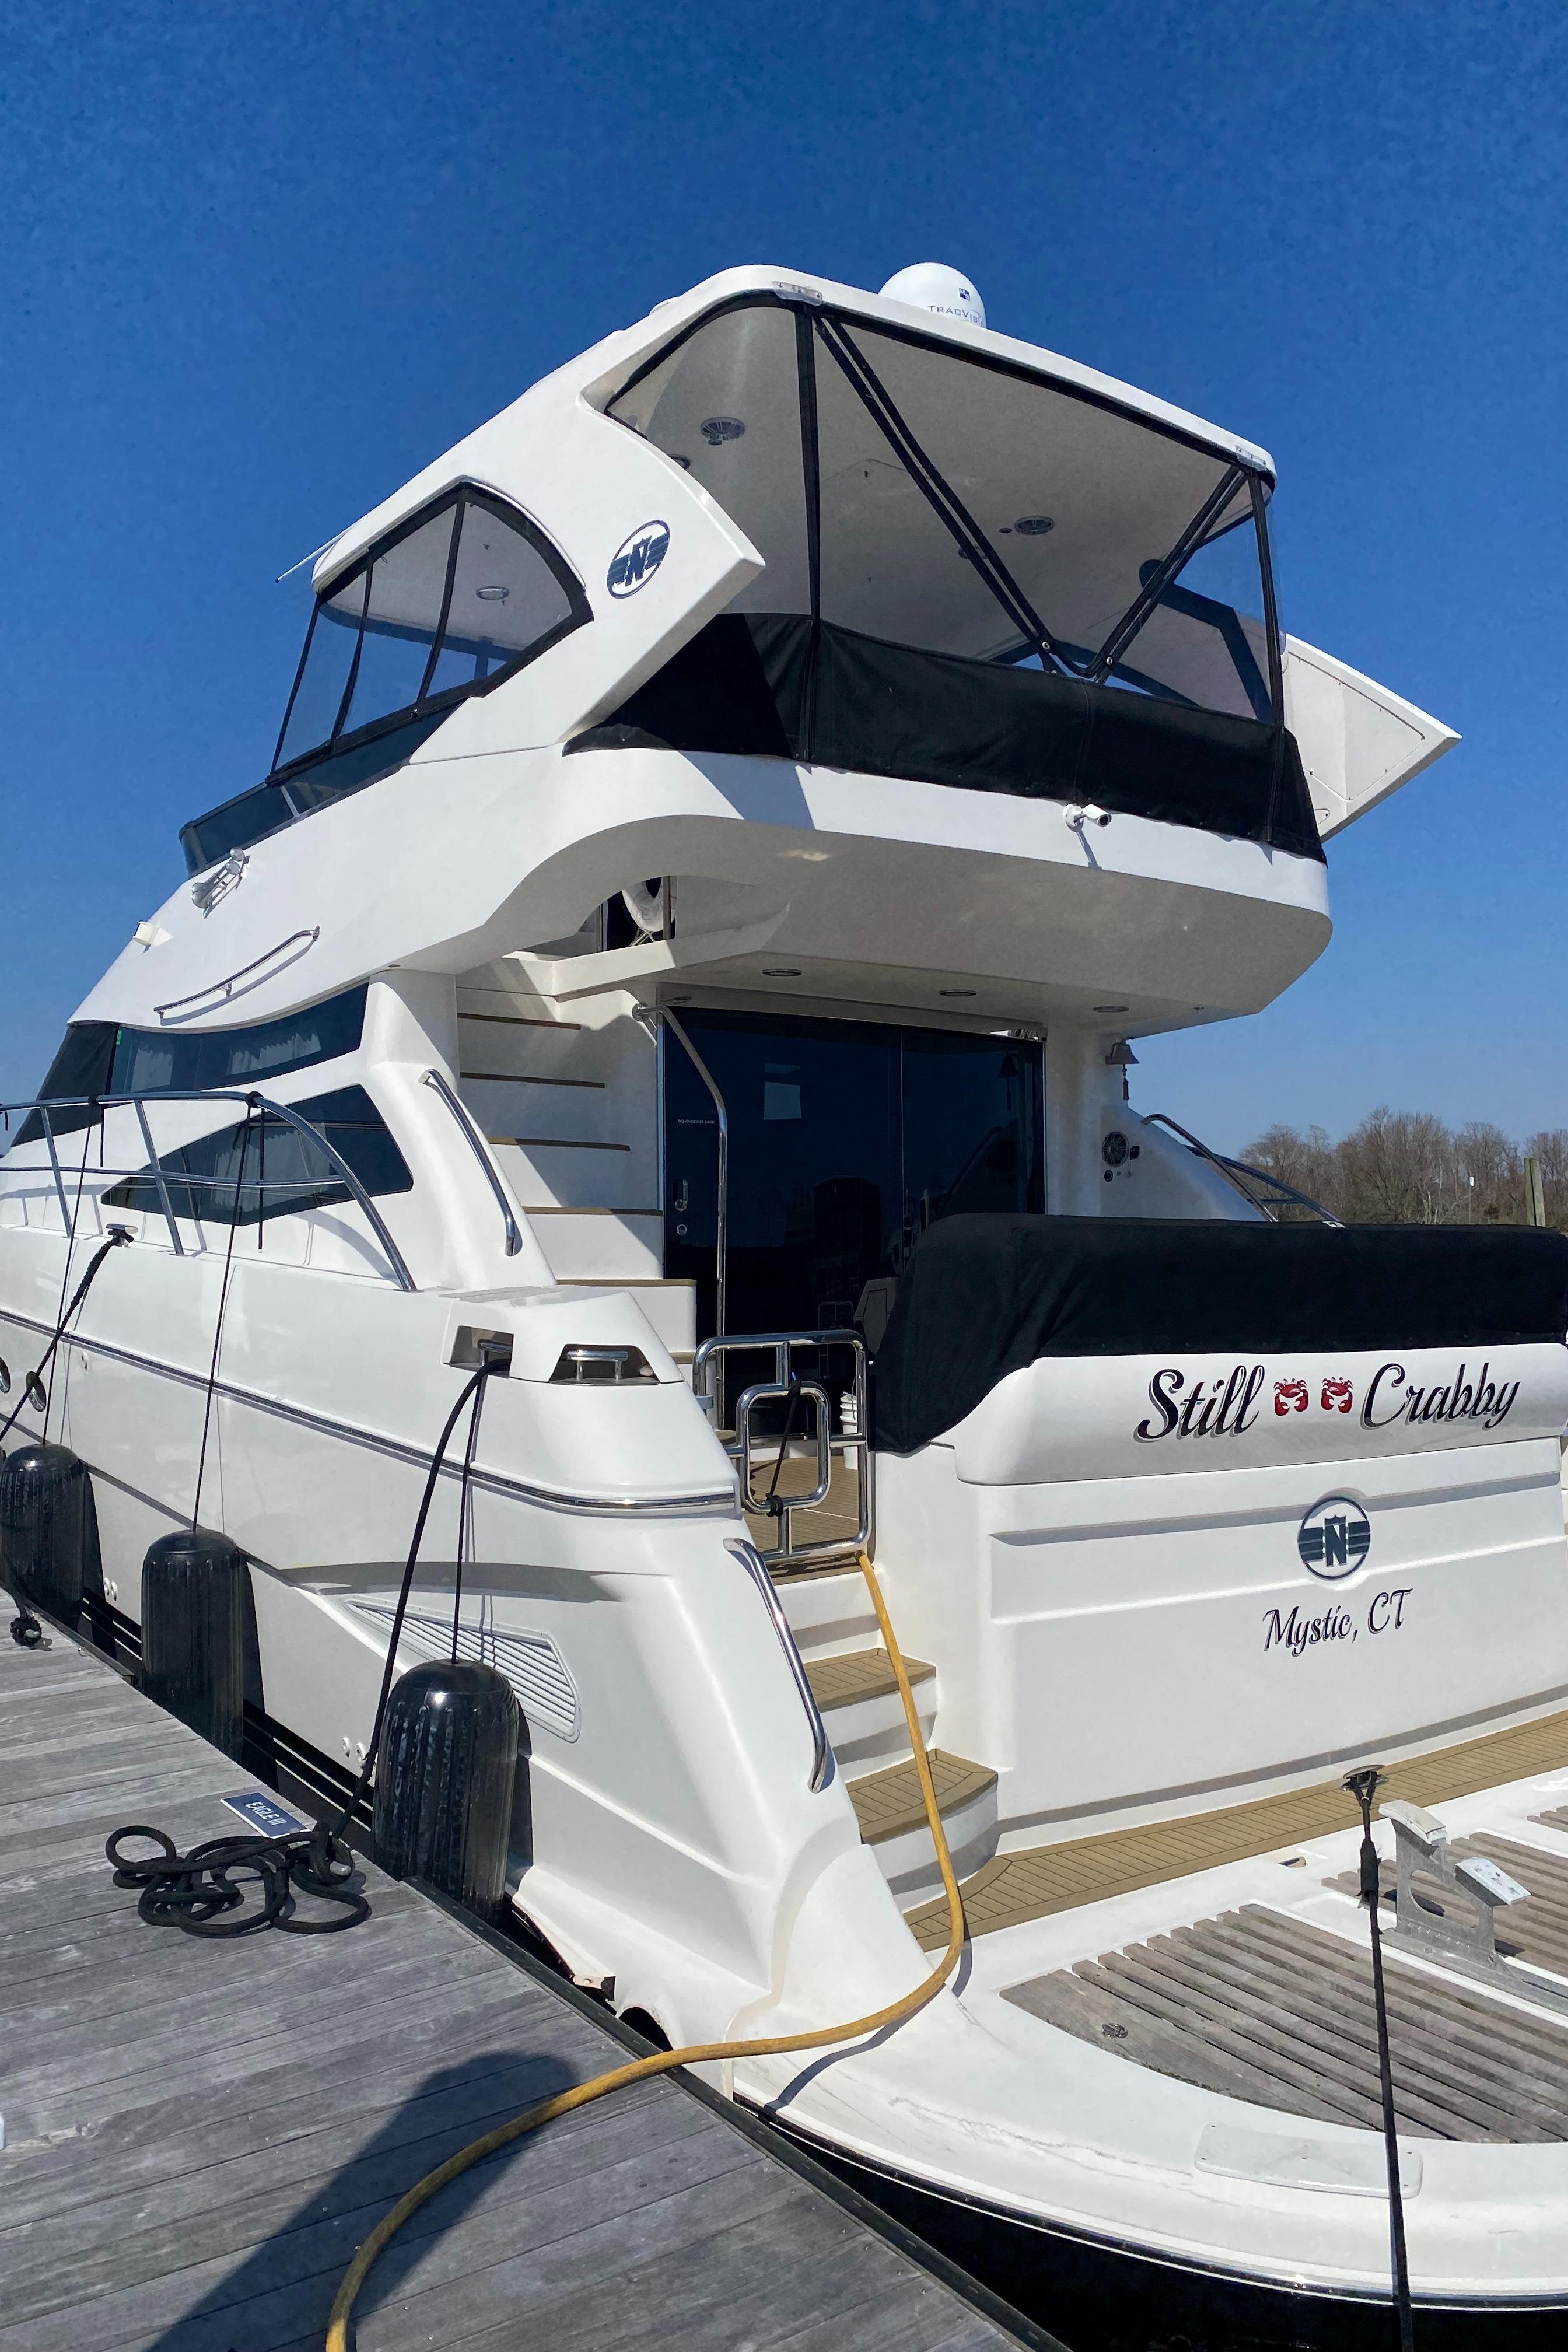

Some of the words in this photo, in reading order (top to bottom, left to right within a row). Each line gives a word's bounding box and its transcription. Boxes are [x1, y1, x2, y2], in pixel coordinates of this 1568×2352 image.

[1134, 1365, 1265, 1441] Still
[1360, 1362, 1520, 1430] Crabby
[1262, 1605, 1358, 1657] Mystic,
[1367, 1588, 1413, 1635] CT
[245, 1801, 279, 1820] EAGLE
[267, 1818, 287, 1826] III
